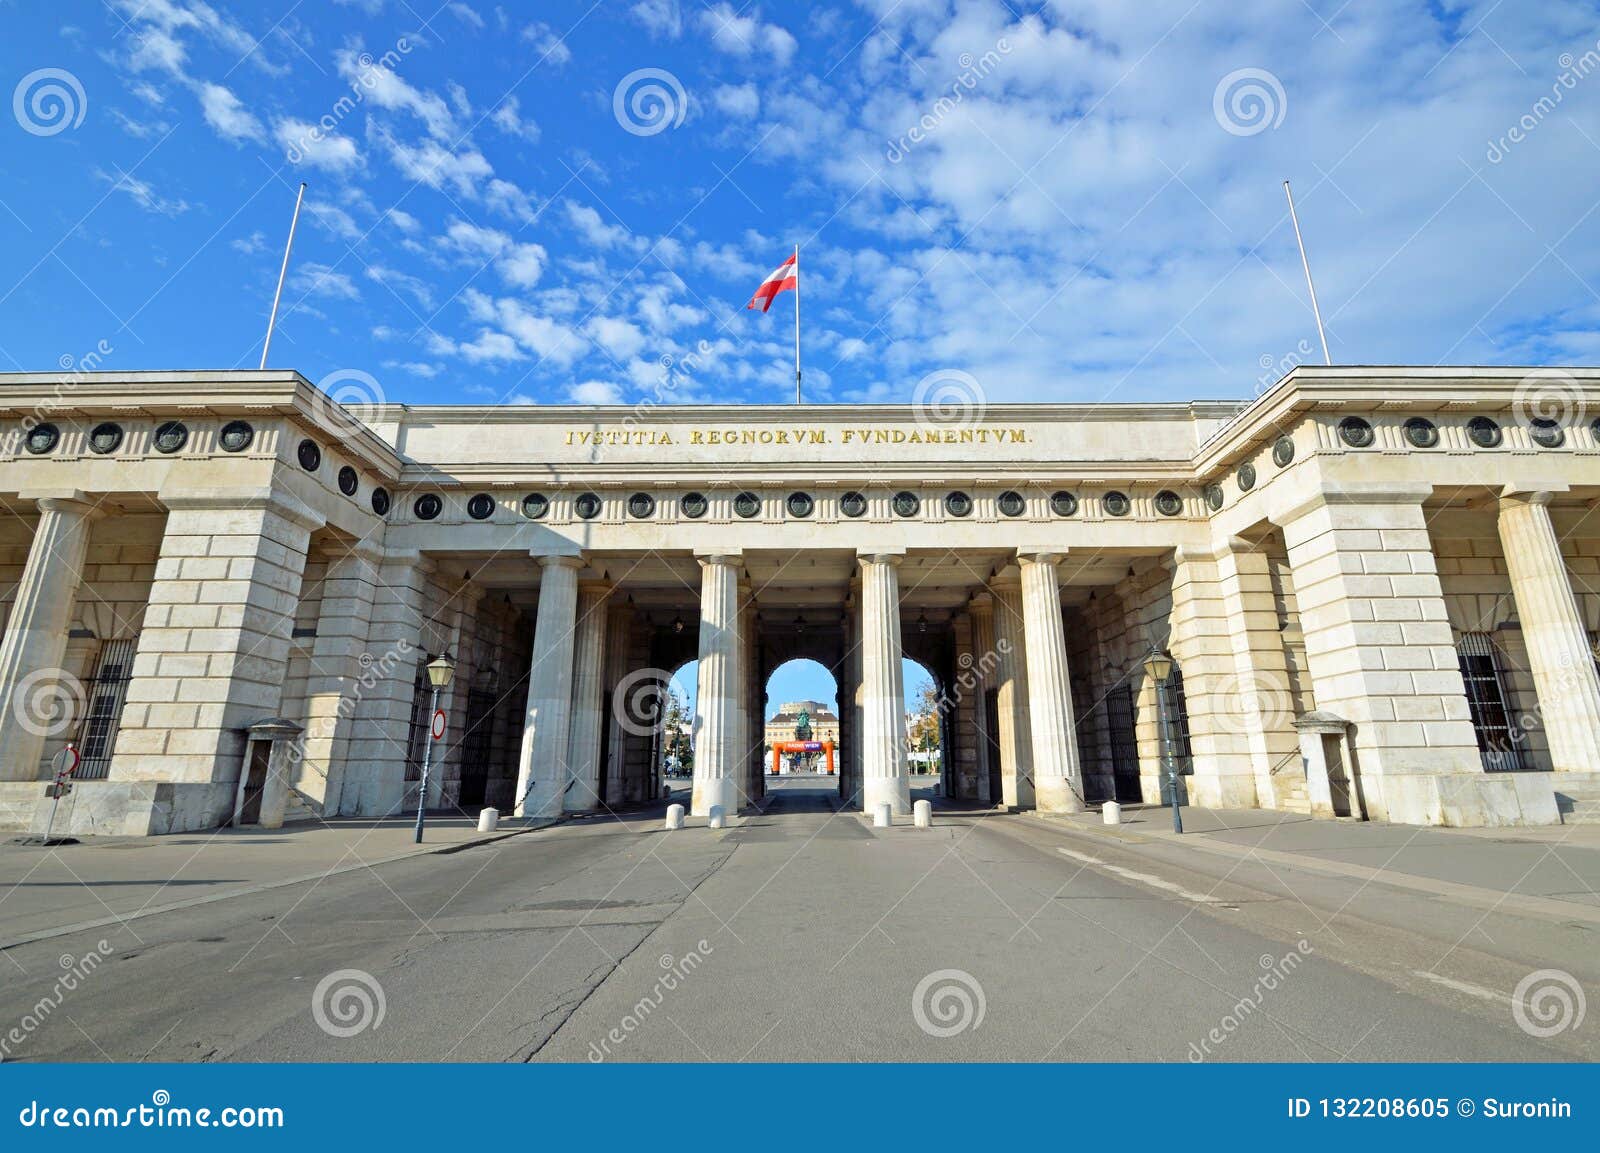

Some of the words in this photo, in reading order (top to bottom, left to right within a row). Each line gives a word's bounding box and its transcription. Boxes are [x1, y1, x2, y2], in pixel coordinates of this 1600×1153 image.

[566, 431, 680, 445] IVSTITIA.
[690, 430, 832, 444] REGNORVM.
[841, 429, 1033, 443] FVNDAMENTVM.
